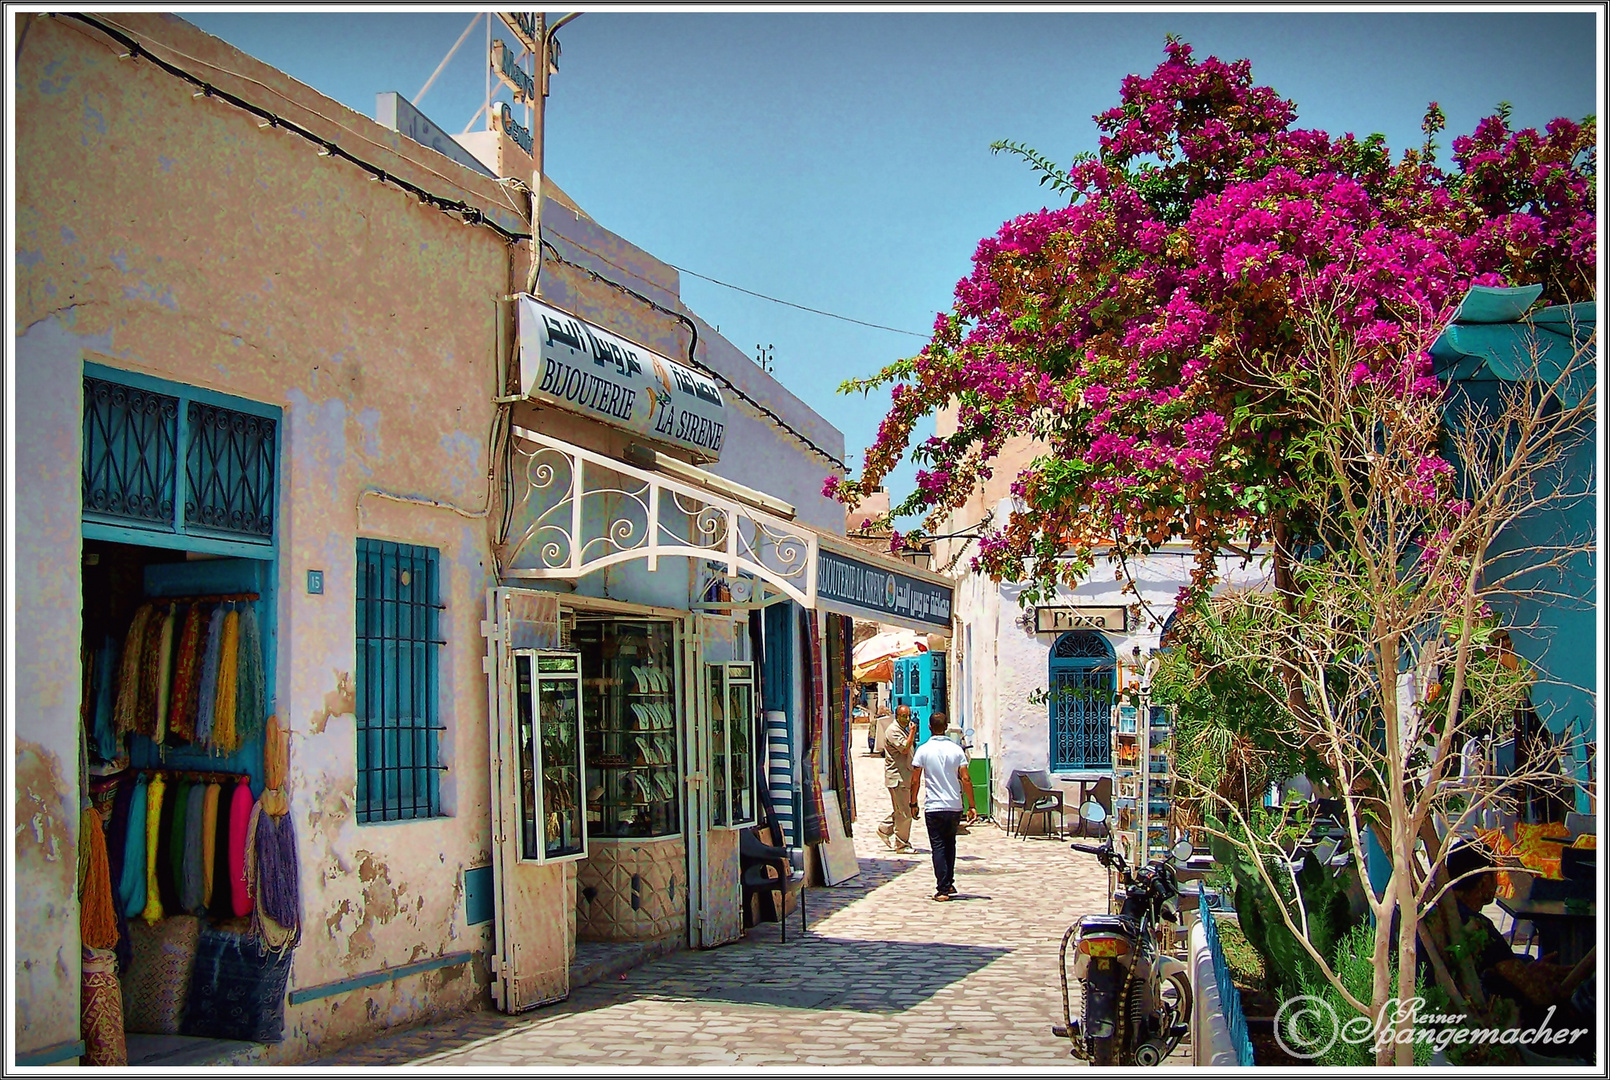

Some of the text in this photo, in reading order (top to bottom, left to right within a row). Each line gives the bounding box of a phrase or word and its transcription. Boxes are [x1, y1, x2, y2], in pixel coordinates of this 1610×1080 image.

[541, 314, 588, 355] البحر
[587, 330, 643, 378] عروس
[538, 357, 724, 452] BIJOUTERIE LA SIRENE
[311, 576, 320, 589] 15
[817, 555, 885, 607] BIJOUTERIE LA SIRENE
[1053, 611, 1106, 629] Pizza
